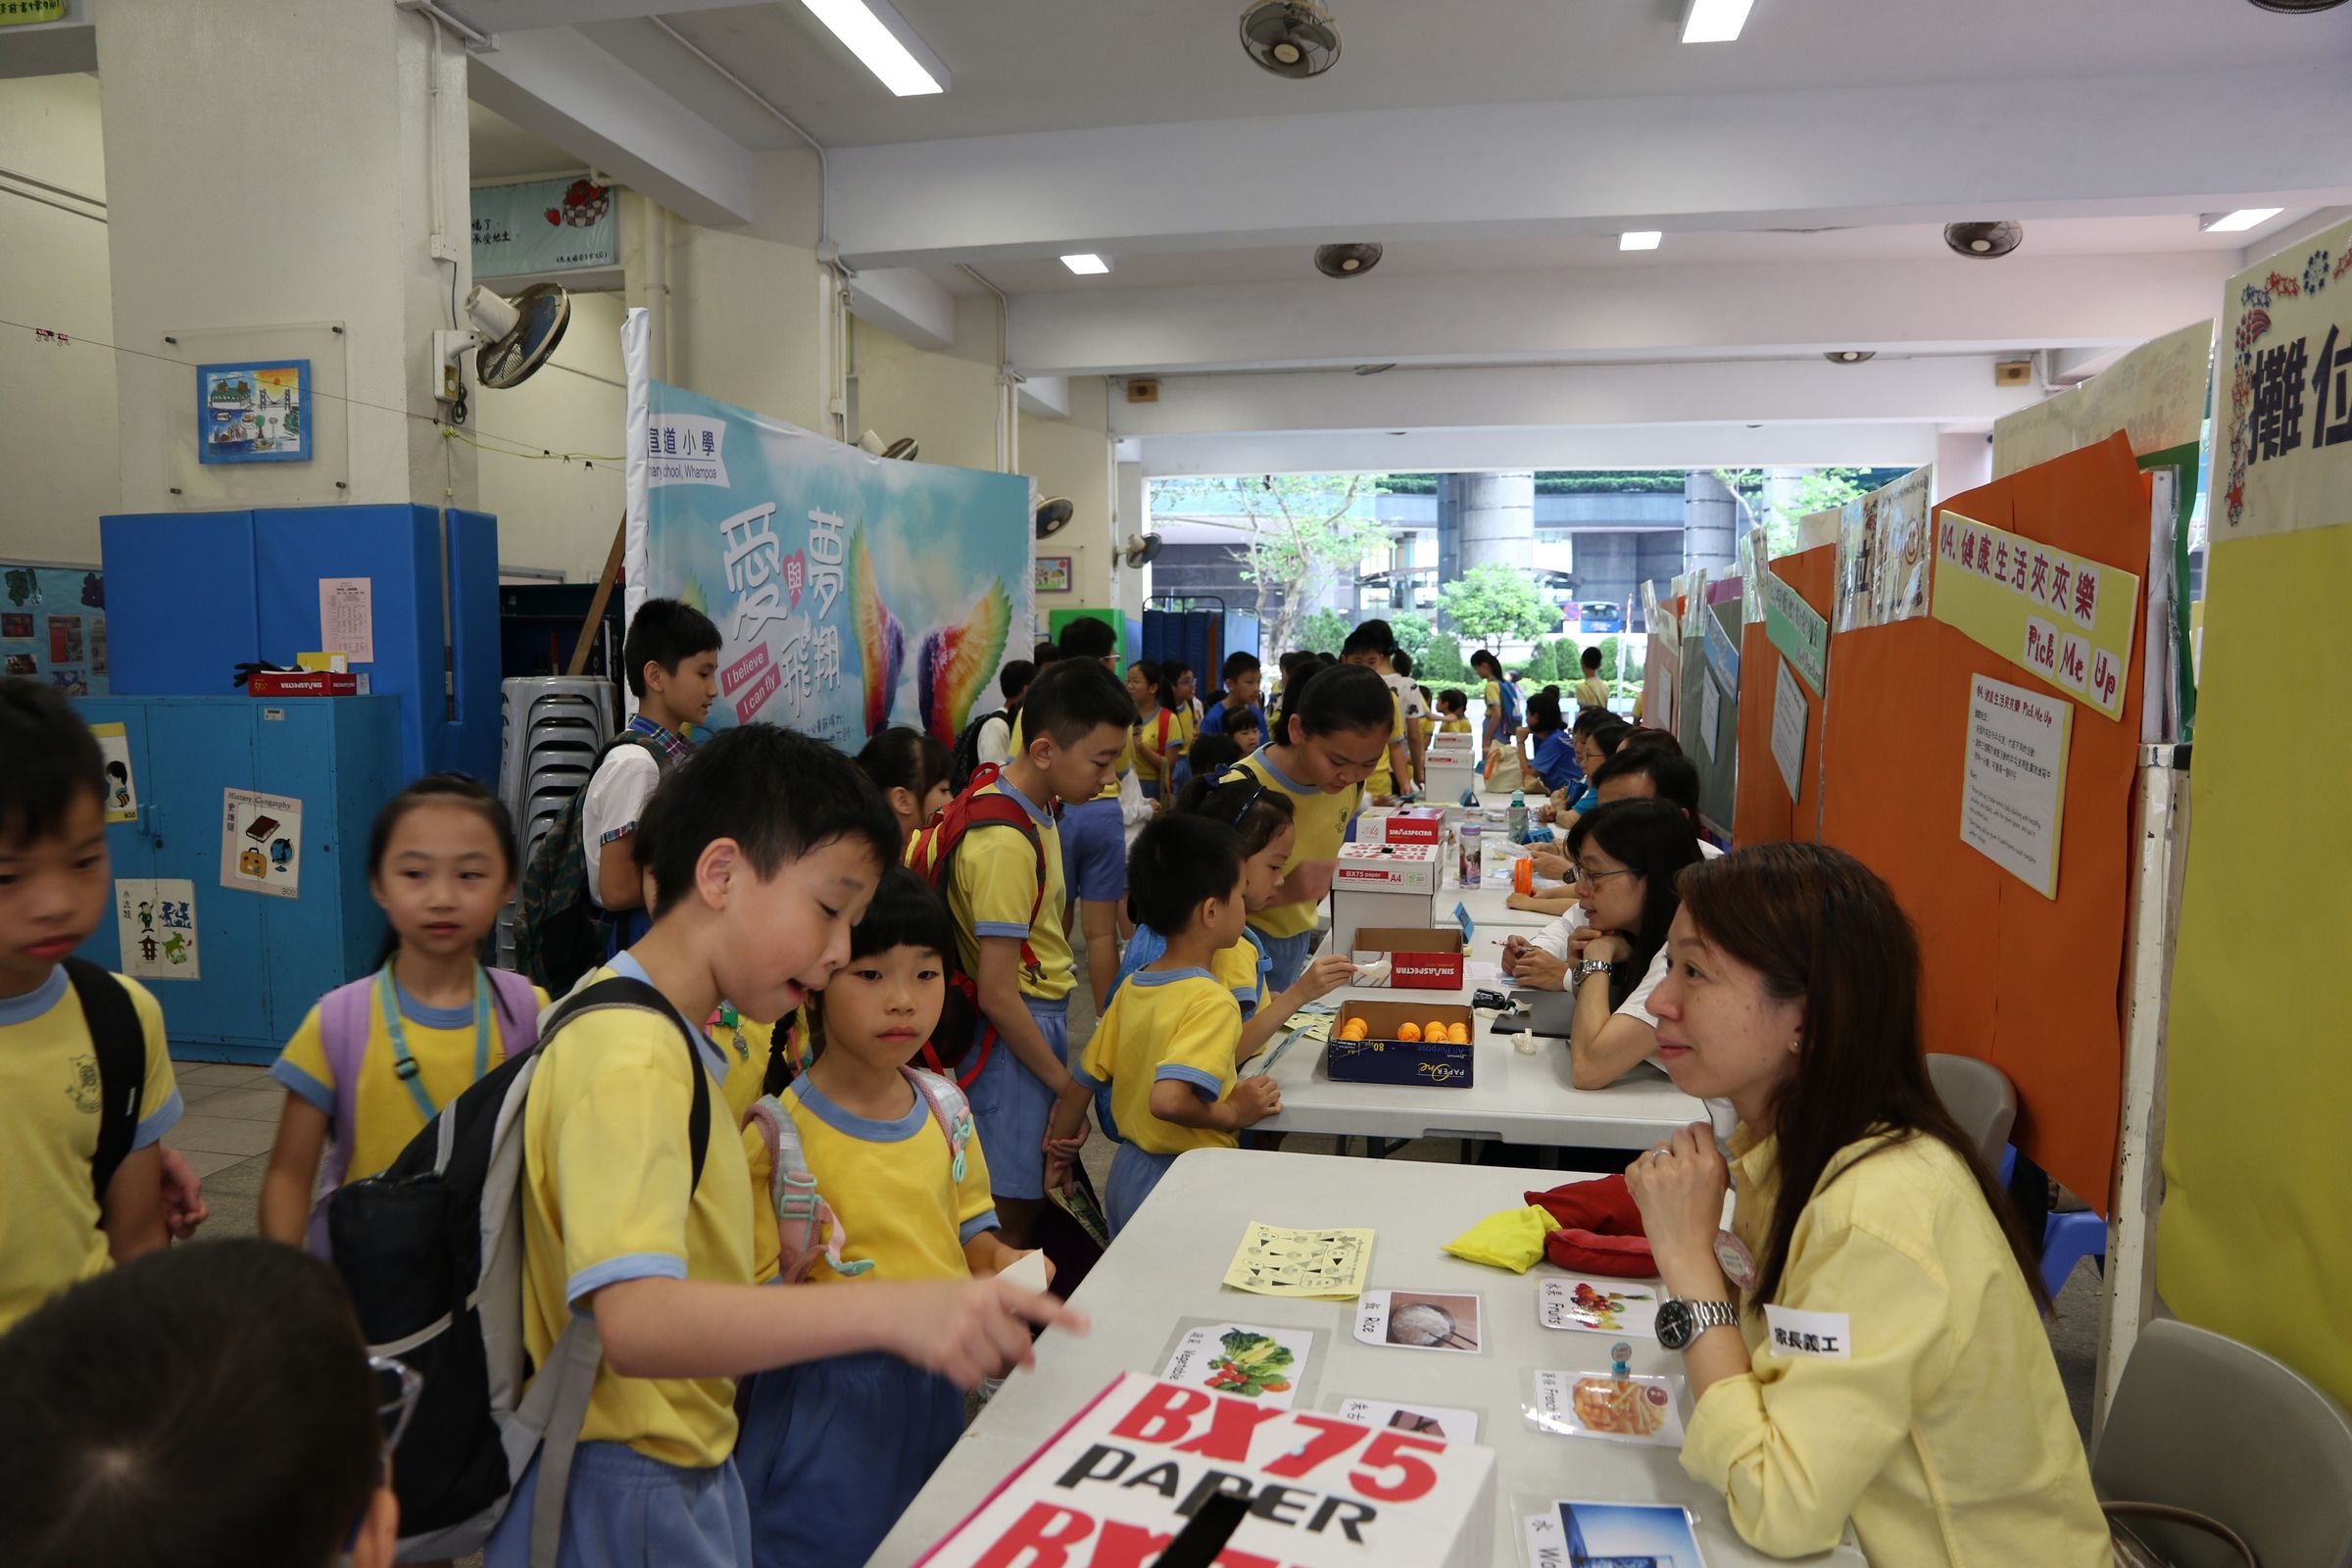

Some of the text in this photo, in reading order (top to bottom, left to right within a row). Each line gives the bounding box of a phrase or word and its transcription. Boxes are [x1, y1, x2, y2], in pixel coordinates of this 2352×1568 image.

[684, 465, 717, 481] Whampoa
[1961, 527, 2095, 621] 健康生活夾夾樂
[732, 651, 764, 684] believe
[2028, 624, 2116, 704] Pick Me Up
[750, 688, 765, 710] can
[764, 674, 776, 695] fly
[1390, 873, 1401, 883] A4
[1373, 1042, 1385, 1052] 80
[1362, 1316, 1381, 1333] Rice
[1547, 1301, 1565, 1324] Fruits
[1774, 1327, 1839, 1352] 家長義工
[1169, 1349, 1198, 1380] Vegetable
[1110, 1381, 1448, 1503] BX75
[1532, 1518, 1553, 1532] 水
